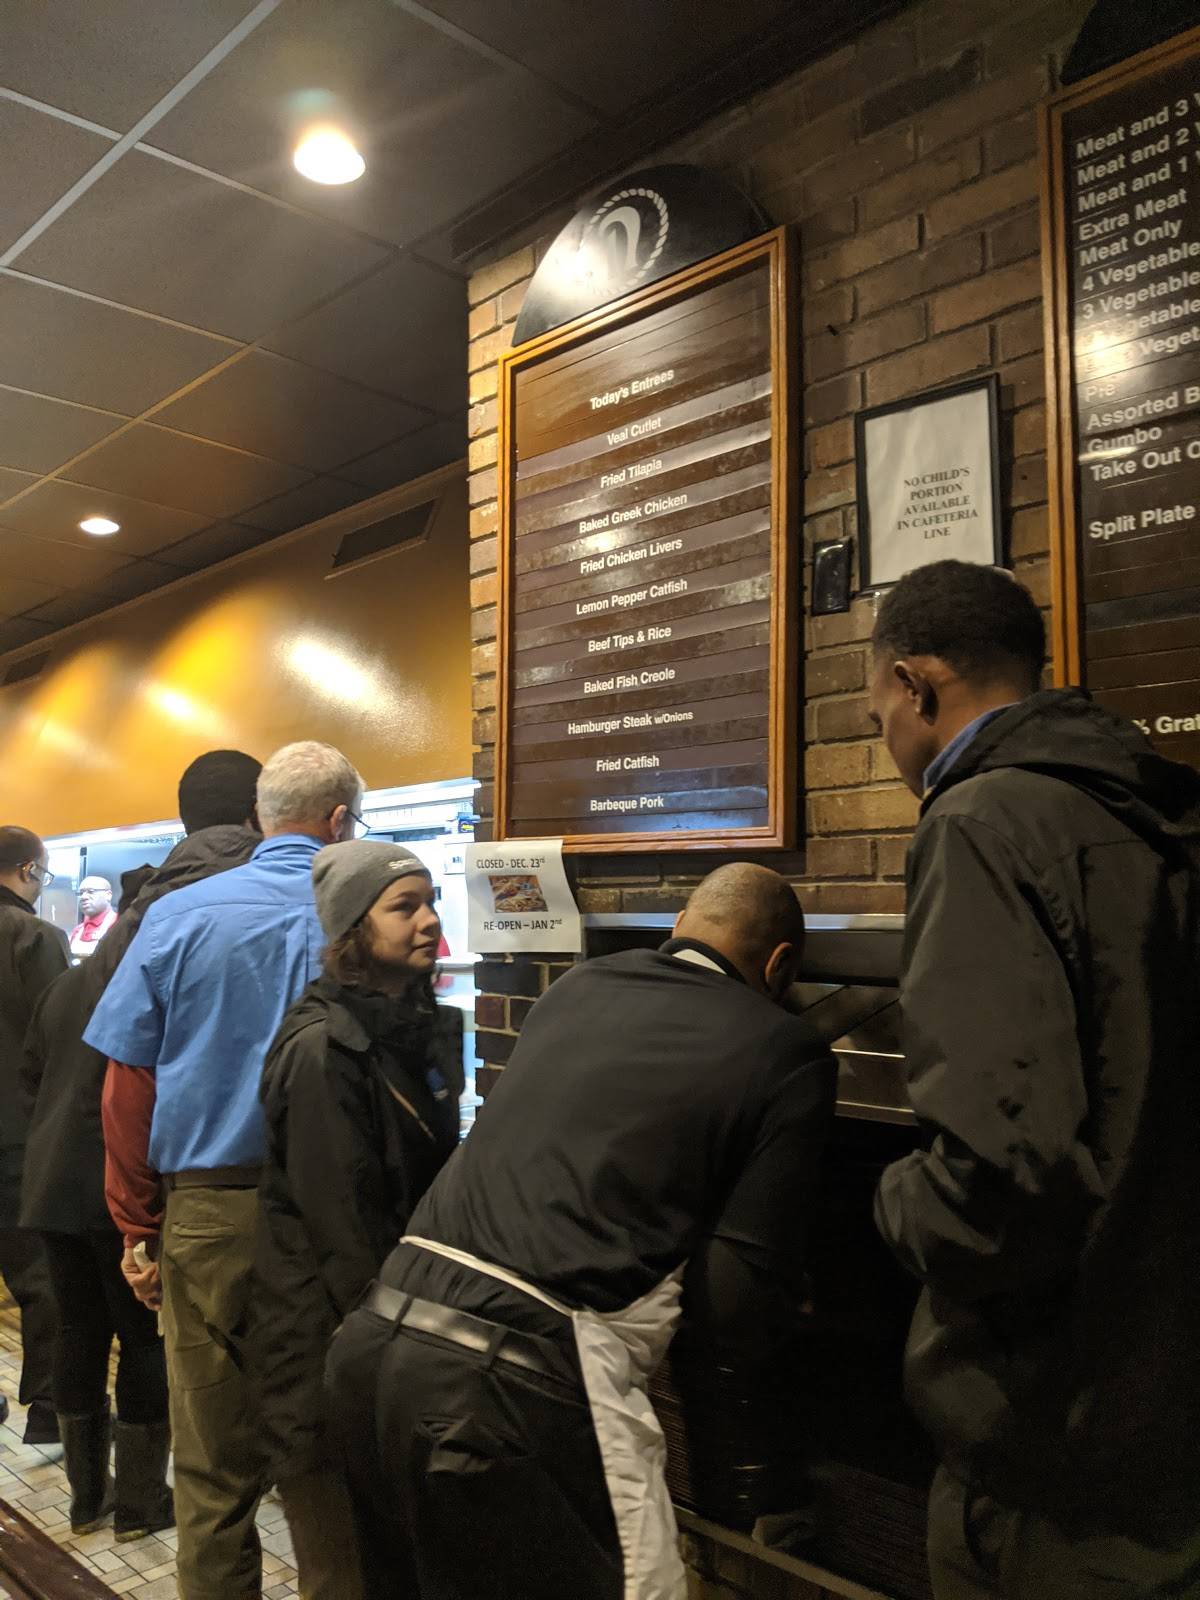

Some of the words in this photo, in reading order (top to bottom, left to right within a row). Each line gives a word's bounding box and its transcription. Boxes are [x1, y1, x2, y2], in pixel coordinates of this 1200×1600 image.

[1076, 126, 1125, 159] Meat
[1130, 106, 1170, 136] and
[1175, 99, 1189, 117] 3
[1077, 153, 1126, 186] Meat
[1130, 134, 1170, 164] and
[1175, 128, 1190, 146] 2
[1077, 181, 1127, 213] Meat
[1131, 163, 1171, 192] and
[1177, 156, 1188, 173] 1
[1078, 212, 1130, 241] Extra
[1135, 188, 1187, 221] Meat
[1079, 236, 1129, 267] Meat
[1133, 219, 1183, 247] Only
[1081, 275, 1096, 292] 4
[1082, 303, 1095, 319] 3
[590, 386, 630, 410] Today's
[631, 369, 674, 397] Entrees
[1087, 391, 1179, 431] Assorted
[607, 428, 629, 446] Veal
[630, 417, 661, 437] Cutlet
[1087, 426, 1163, 452] Gumbo
[600, 470, 626, 488] Fried
[628, 459, 662, 481] Tilapia
[1089, 458, 1137, 482] Take
[1142, 445, 1181, 469] Out
[904, 476, 920, 487] NO
[921, 468, 970, 484] CHILD'S
[910, 482, 963, 501] PORTION
[579, 515, 609, 534] Baked
[611, 507, 642, 525] Greek
[644, 493, 688, 515] Chicken
[904, 495, 971, 516] AVAILABLE
[897, 519, 910, 531] IN
[912, 509, 978, 528] CAFETERIA
[924, 527, 951, 540] LINE
[1089, 515, 1136, 540] Split
[1141, 504, 1196, 528] Plate
[580, 557, 605, 574] Fried
[607, 548, 647, 568] Chicken
[650, 538, 683, 556] Livers
[576, 600, 609, 615] Lemon
[611, 589, 647, 610] Pepper
[650, 579, 688, 598] Catfish
[588, 637, 611, 652] Beef
[613, 633, 634, 649] Tips
[637, 631, 645, 643] &
[648, 625, 672, 641] Rice
[584, 678, 614, 693] Baked
[616, 673, 638, 688] Fish
[640, 668, 675, 684] Creole
[568, 718, 620, 735] Hamburger
[623, 713, 652, 728] Steak
[654, 711, 693, 724] w/Onions
[596, 758, 621, 772] Fried
[623, 755, 660, 769] Catfish
[590, 798, 637, 813] Barbeque
[640, 796, 664, 808] Pork
[477, 859, 504, 869] CLOSED
[511, 858, 529, 869] DEC.
[530, 857, 545, 868] 23rd
[484, 920, 522, 930] RE-OPEN
[531, 920, 548, 930] JAN
[550, 919, 562, 929] 2nd
